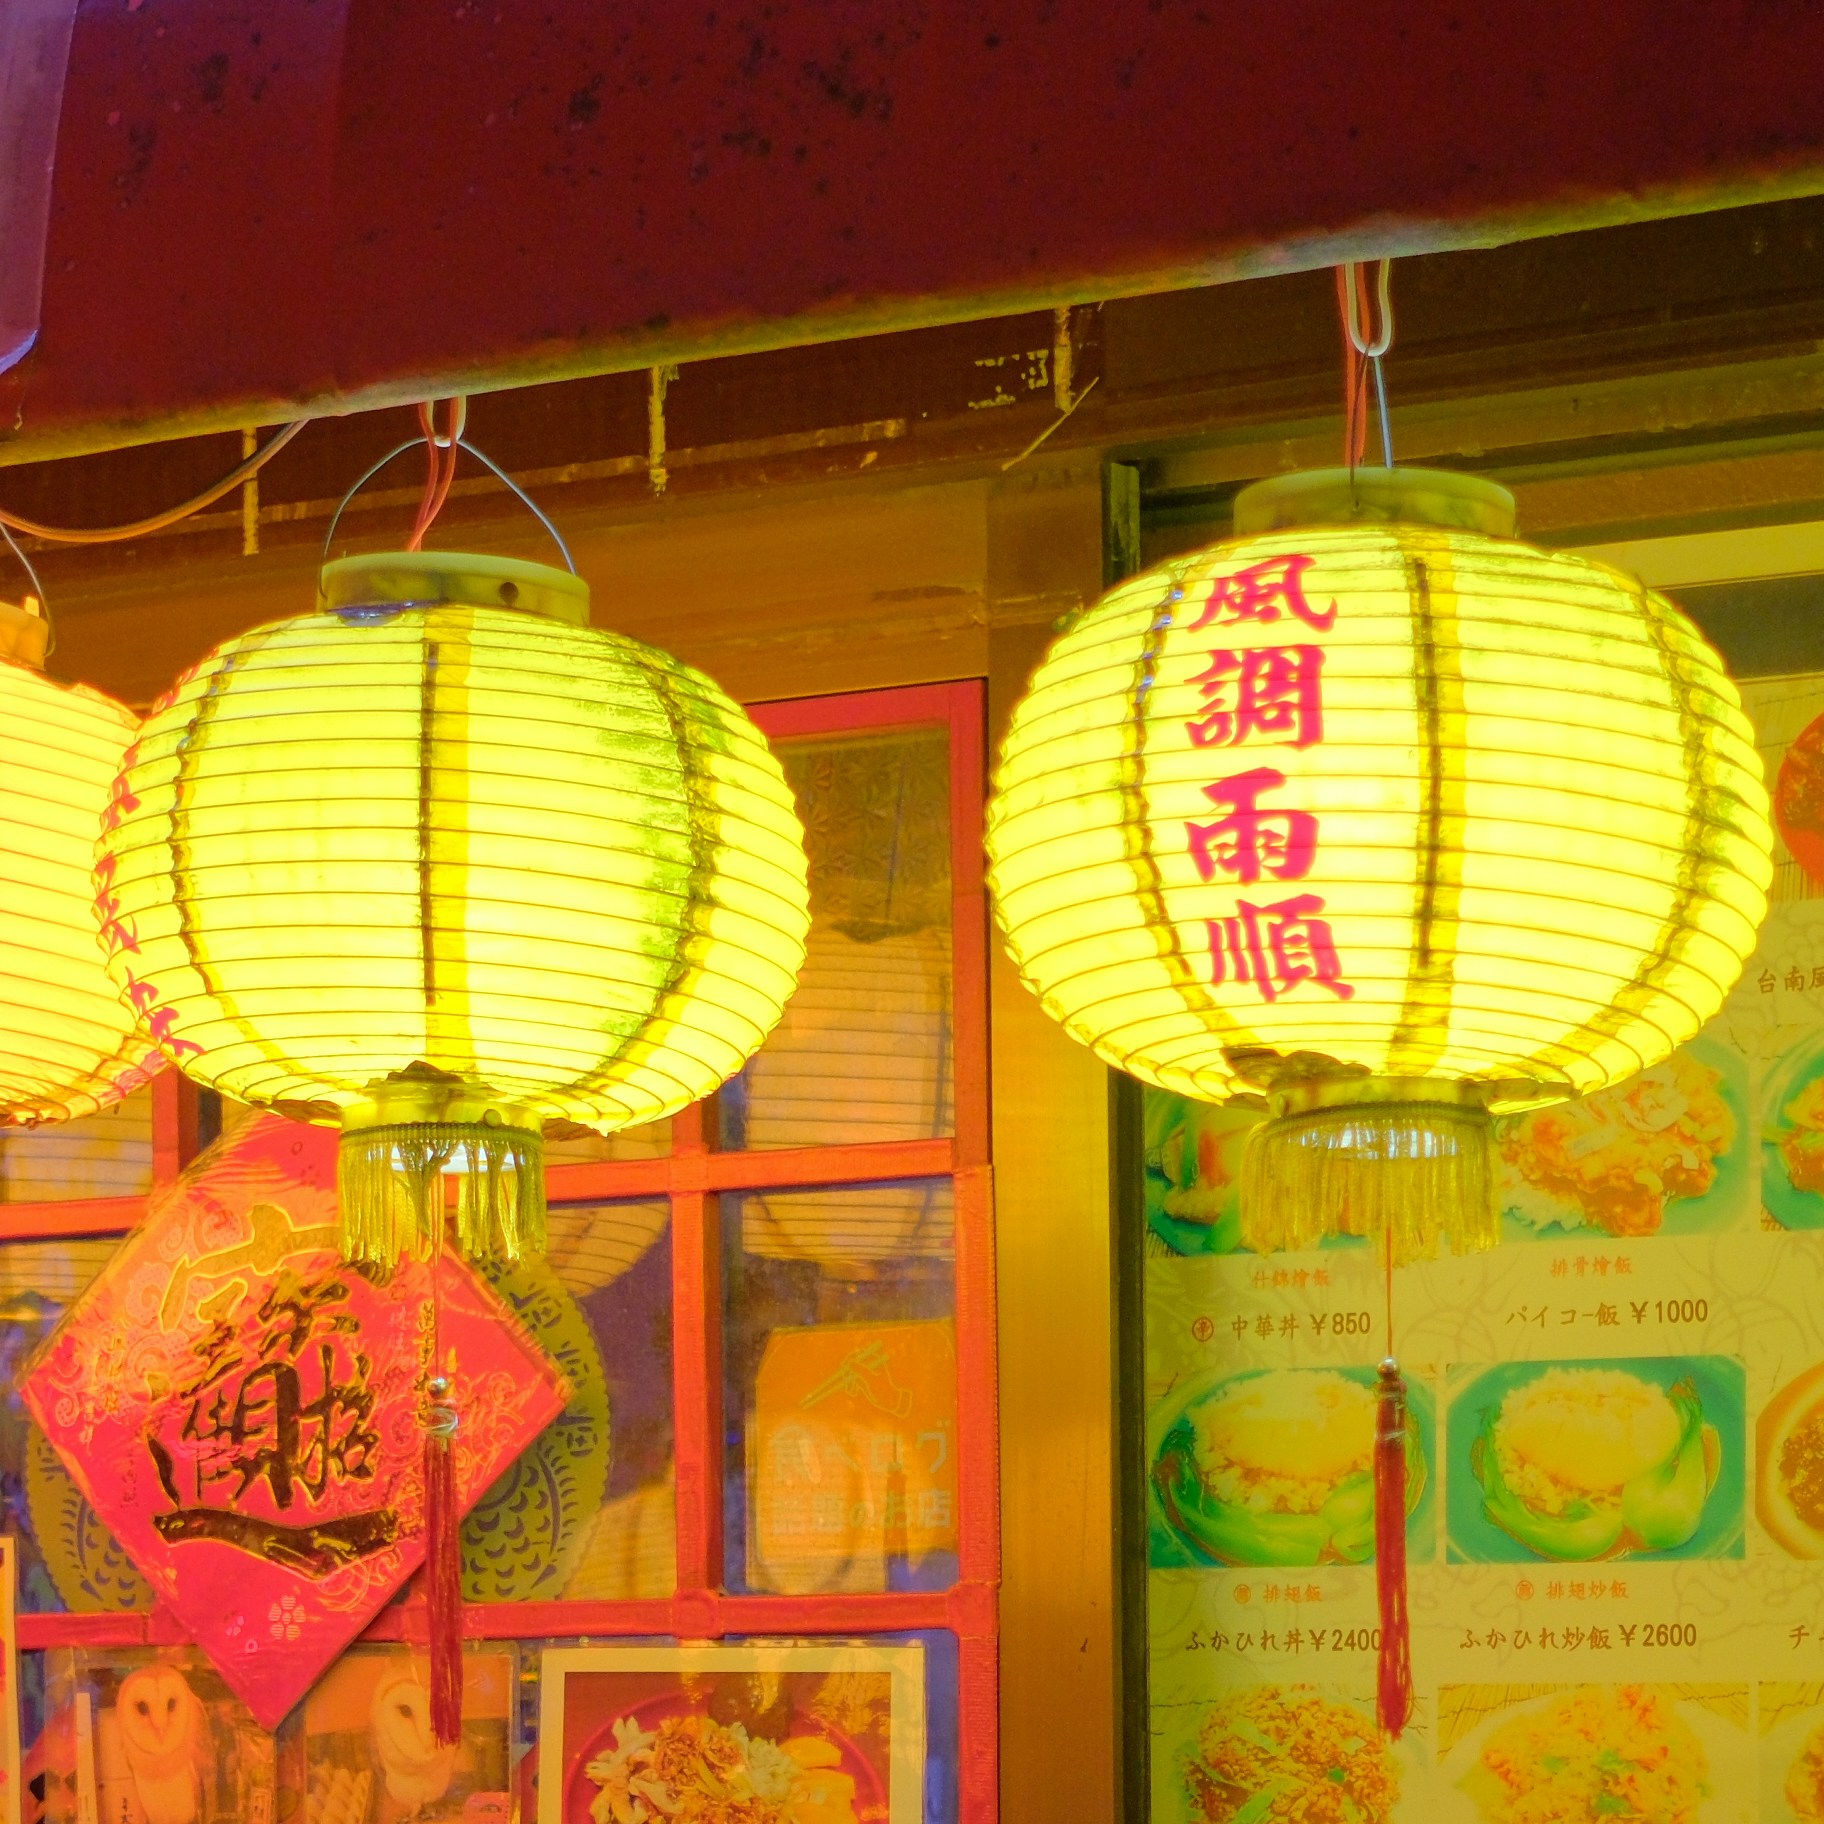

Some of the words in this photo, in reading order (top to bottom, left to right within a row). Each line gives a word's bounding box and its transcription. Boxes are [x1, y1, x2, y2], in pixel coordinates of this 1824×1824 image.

[1186, 552, 1356, 1004] 風調雨順
[1630, 1298, 1709, 1325] ¥1000
[1230, 1313, 1300, 1343] 中華丼
[1311, 1311, 1371, 1337] ¥850
[1185, 1629, 1305, 1654] ふかひれ丼
[1459, 1625, 1612, 1652] ふかひれ炒飯
[1619, 1623, 1697, 1649] ¥2600
